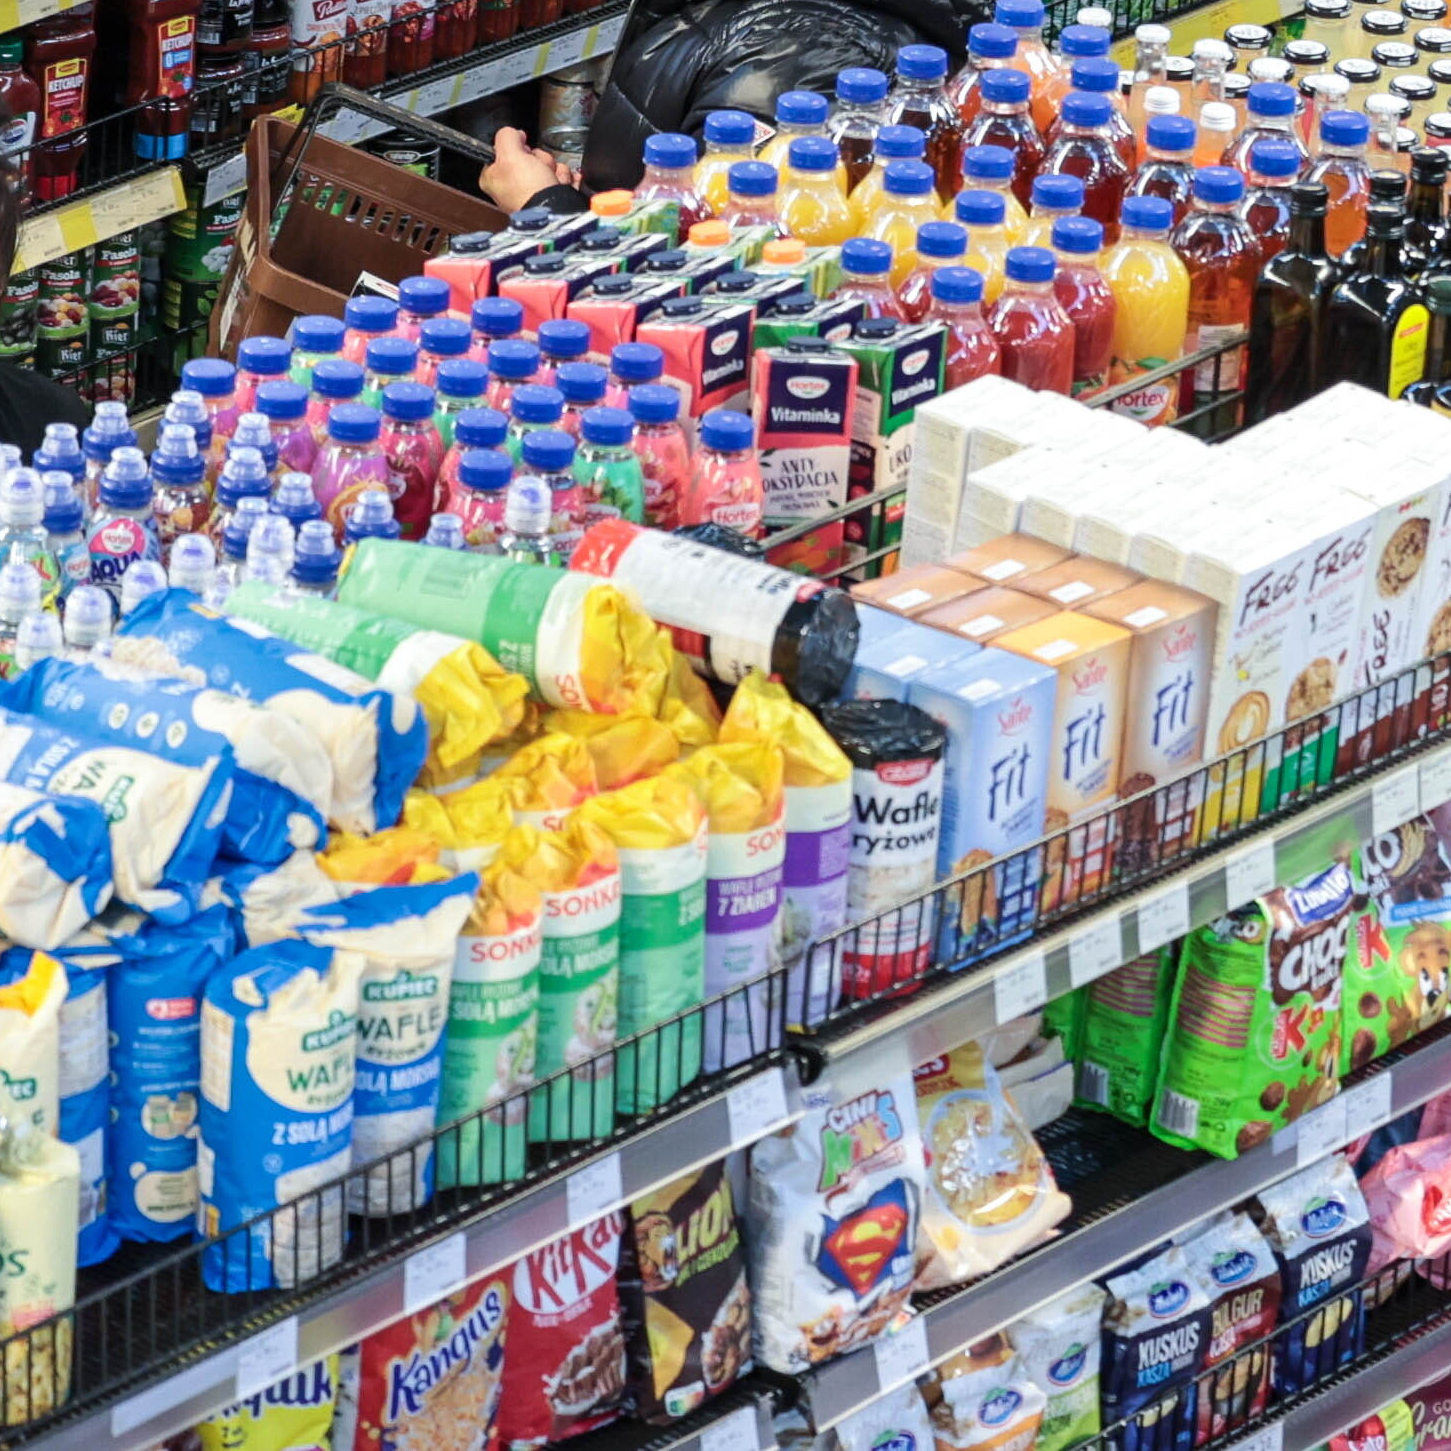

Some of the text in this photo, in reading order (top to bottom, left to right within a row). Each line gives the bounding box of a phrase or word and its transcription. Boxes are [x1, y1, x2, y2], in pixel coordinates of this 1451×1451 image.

[771, 407, 841, 424] Vitaminka
[781, 458, 814, 474] ANTY
[1153, 669, 1196, 746] Fit
[1064, 705, 1107, 782] Fit
[854, 789, 940, 828] Wafle
[988, 746, 1032, 822] Fit
[1300, 1240, 1357, 1289] KUSKUS
[389, 1291, 506, 1423] Kangus
[1138, 1323, 1202, 1370] KUSKUS
